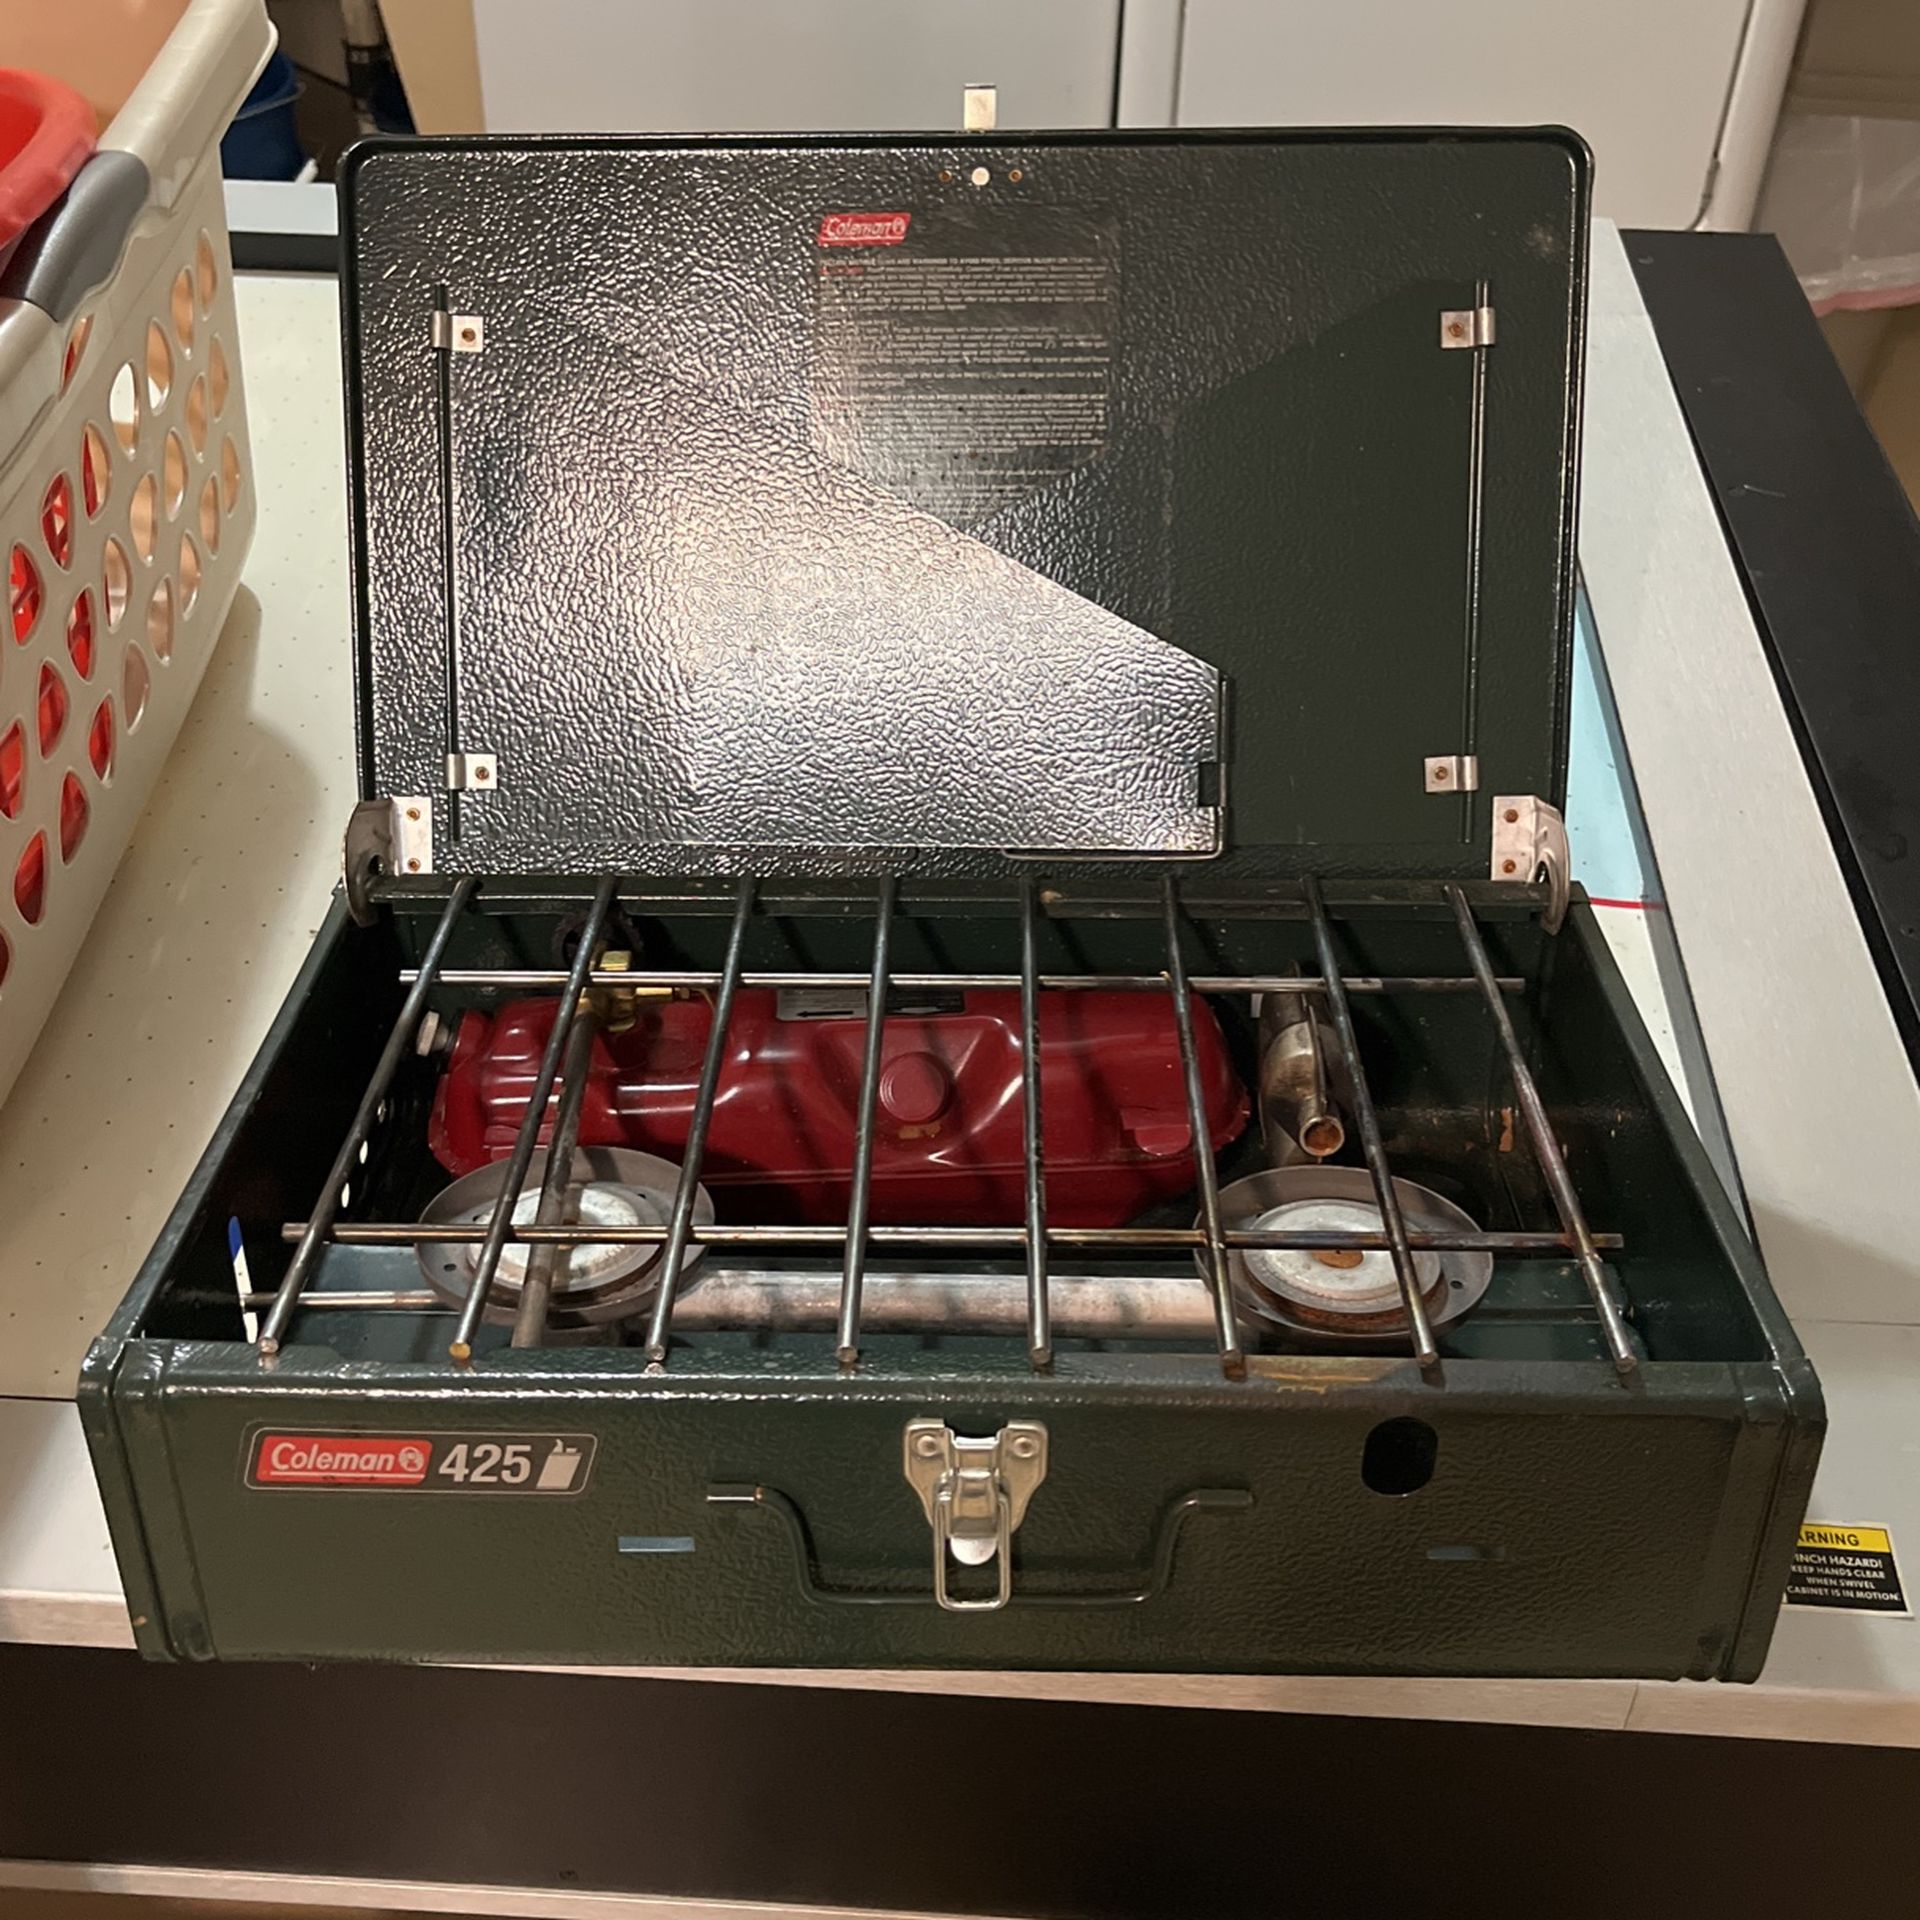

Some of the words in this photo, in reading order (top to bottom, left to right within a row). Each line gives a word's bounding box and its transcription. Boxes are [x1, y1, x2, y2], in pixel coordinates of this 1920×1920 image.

[826, 217, 892, 237] Coleman
[270, 1442, 395, 1471] Coleman
[438, 1443, 532, 1484] 425
[1816, 1566, 1852, 1577] HANDS
[1853, 1569, 1886, 1579] CLEAR
[1806, 1577, 1837, 1586] WHEN
[1839, 1579, 1876, 1589] SWIVEL
[1786, 1585, 1829, 1596] CABINET
[1830, 1588, 1841, 1597] IS
[1842, 1589, 1854, 1598] IN
